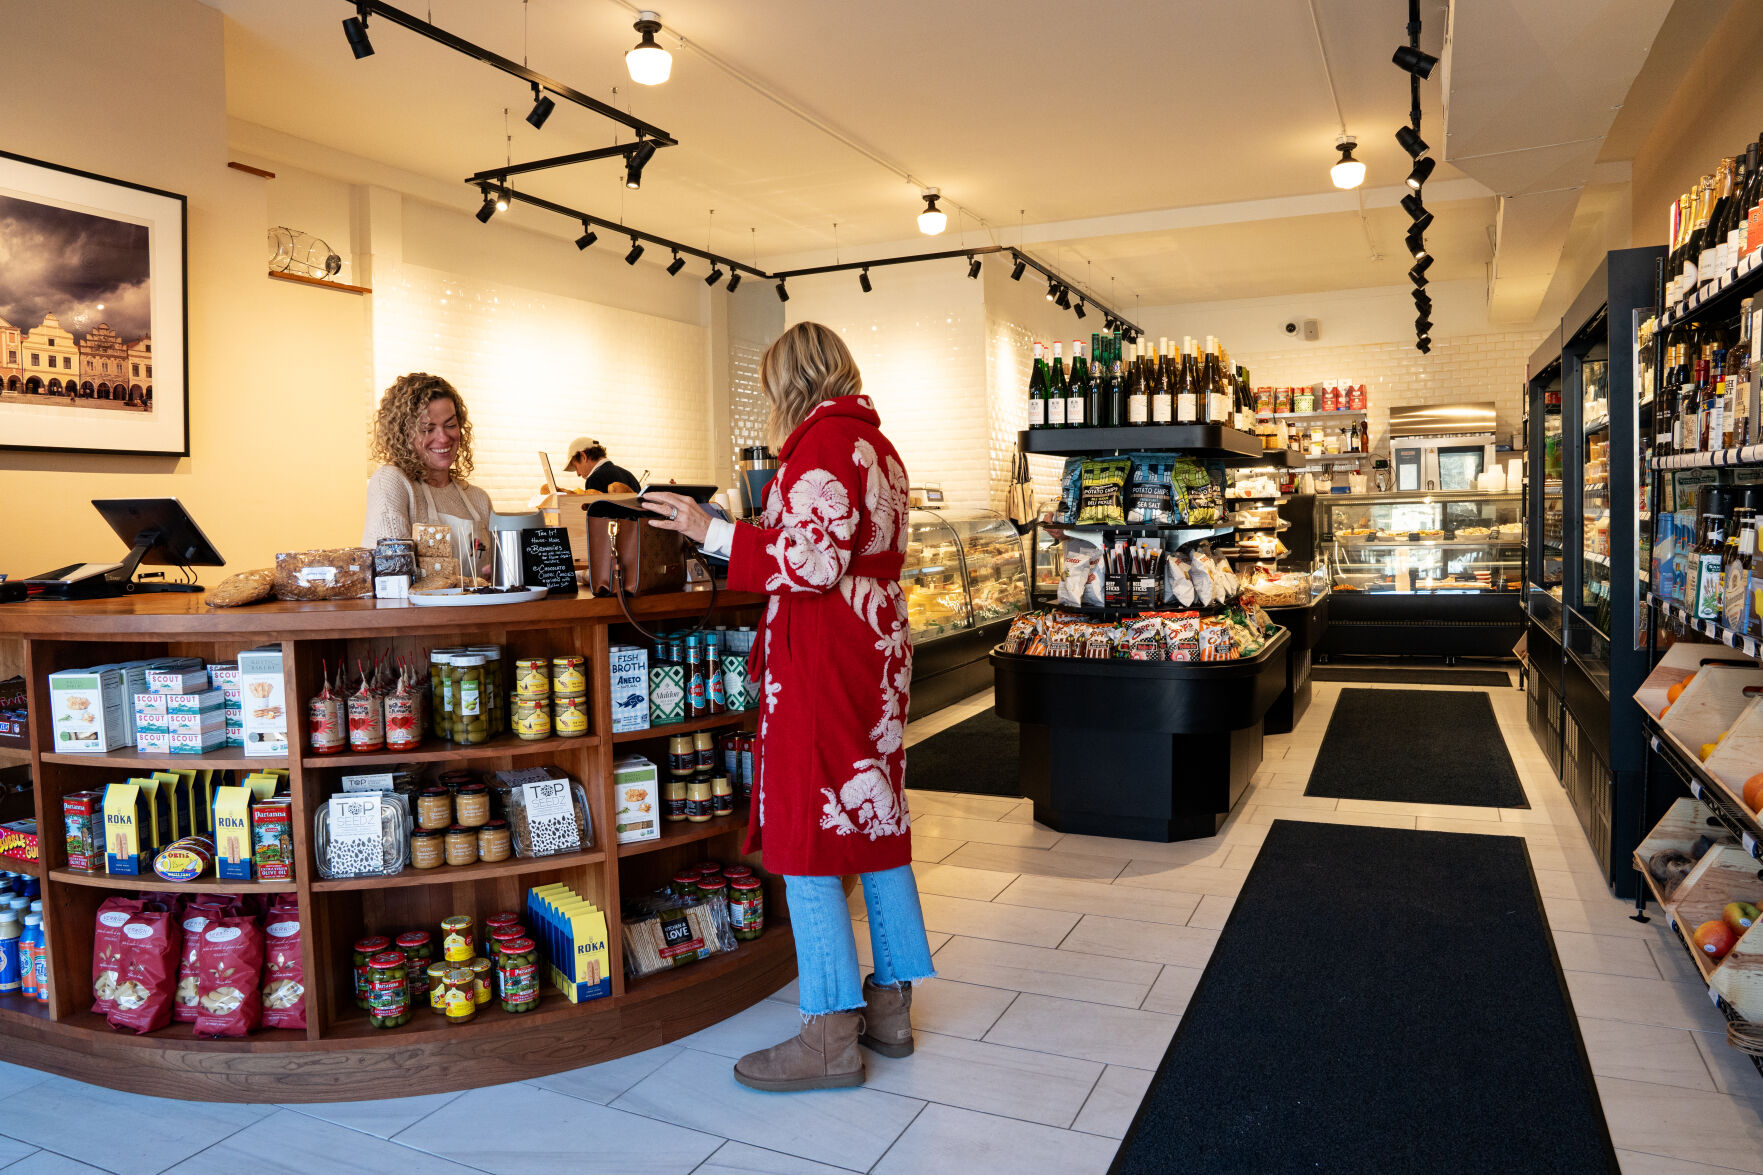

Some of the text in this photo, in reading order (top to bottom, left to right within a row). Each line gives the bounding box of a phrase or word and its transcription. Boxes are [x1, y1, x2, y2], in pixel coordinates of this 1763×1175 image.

[617, 653, 639, 663] FISH
[612, 662, 646, 673] BROTH
[152, 675, 178, 683] SCOUT
[137, 695, 163, 703] SCOUT
[169, 695, 196, 703] SCOUT
[349, 778, 367, 787] TOP
[530, 783, 564, 799] TOP
[531, 795, 567, 809] SEEDZ
[336, 801, 375, 816] TOP
[107, 814, 132, 824] ROKA
[254, 811, 286, 820] Partanna
[336, 815, 376, 826] SEEDZ
[218, 817, 244, 828] ROKA
[666, 926, 689, 940] LOVE
[577, 941, 605, 954] ROKA
